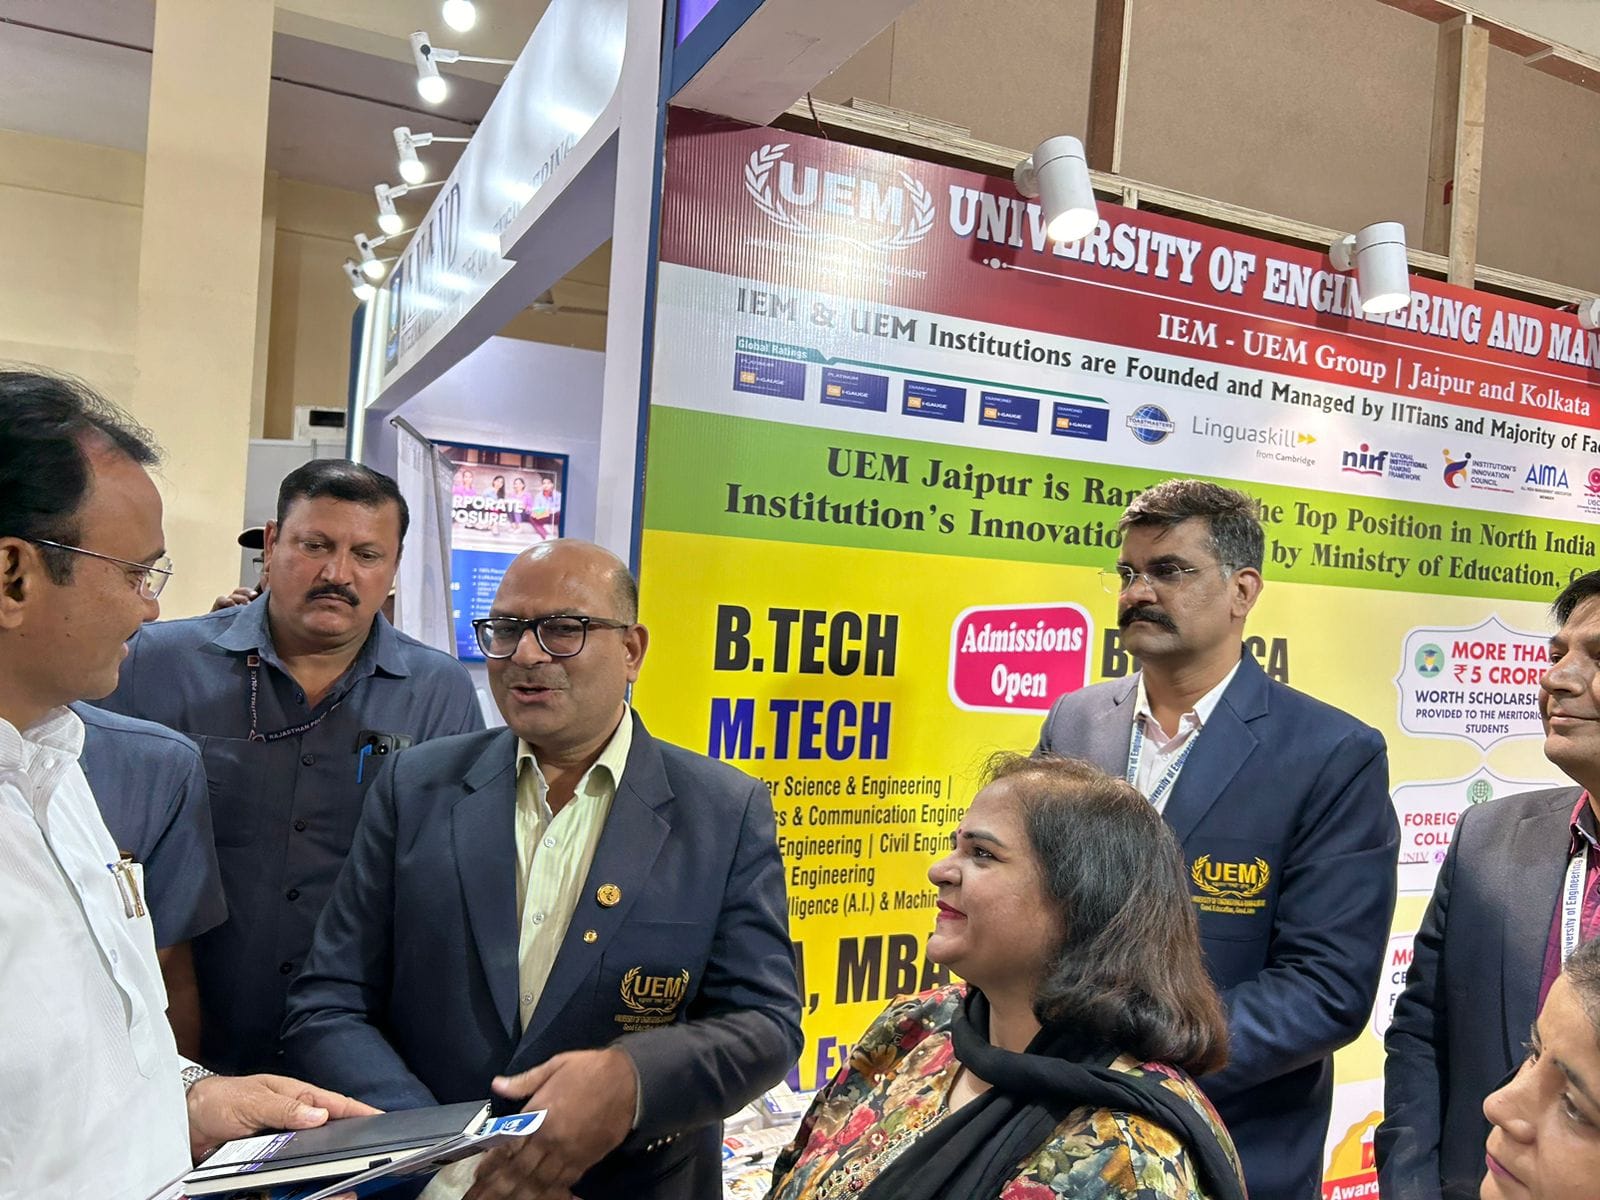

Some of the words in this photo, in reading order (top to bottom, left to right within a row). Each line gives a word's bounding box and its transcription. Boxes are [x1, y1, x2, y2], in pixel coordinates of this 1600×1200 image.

[778, 160, 904, 226] UEM
[1209, 246, 1256, 297] OF
[1487, 310, 1543, 358] AND
[738, 338, 769, 353] Global
[772, 344, 808, 360] Ratings
[736, 287, 798, 322] IEM
[809, 300, 835, 329] &
[849, 307, 918, 342] UEM
[928, 321, 1072, 368] Institutions
[1081, 351, 1117, 375] are
[1126, 357, 1219, 392] Founded
[1227, 376, 1264, 399] and
[1271, 381, 1354, 414] Managed
[1362, 395, 1384, 422] by
[1390, 401, 1449, 429] IITians
[1455, 412, 1484, 435] and
[1490, 420, 1556, 450] Majority
[1561, 433, 1578, 449] of
[1158, 314, 1218, 348] IEM
[1243, 328, 1308, 364] UEM
[1314, 345, 1387, 381] Group
[1408, 362, 1475, 395] Jaipur
[1479, 373, 1515, 402] and
[1520, 379, 1591, 417] Kolkata
[1192, 416, 1296, 448] Linguaskill
[1256, 450, 1274, 460] from
[1275, 453, 1316, 466] Cambridge
[1472, 460, 1517, 472] INSTITUTION'S
[1470, 477, 1498, 486] COUNCIL
[1471, 470, 1510, 480] INNOVATION
[1525, 464, 1569, 488] AIMA
[828, 447, 909, 484] UEM
[921, 459, 1033, 500] Jaipur
[1043, 473, 1069, 501] is
[1293, 501, 1338, 535] Top
[1347, 508, 1442, 540] Position
[1451, 521, 1472, 544] in
[1480, 524, 1537, 551] North
[1545, 531, 1596, 557] India
[724, 483, 955, 535] Institution's
[1271, 540, 1302, 568] by
[1310, 543, 1410, 578] Ministry
[1418, 555, 1443, 577] of
[714, 604, 899, 677] B.TECH
[960, 621, 1083, 653] Admissions
[1451, 641, 1507, 661] MORE
[991, 664, 1047, 703] Open
[1415, 690, 1465, 704] WORTH
[1416, 709, 1463, 720] PROVIDED
[1465, 710, 1477, 719] TO
[1480, 710, 1496, 719] THE
[269, 724, 310, 740] RAJASTHAN
[708, 698, 891, 761] M.TECH
[1465, 723, 1509, 734] STUDENTS
[784, 776, 841, 797] Science
[846, 776, 857, 794] &
[861, 775, 941, 799] Engineering
[793, 807, 803, 826] &
[809, 804, 916, 826] Communication
[778, 835, 862, 860] Engineering
[880, 832, 910, 853] Civil
[791, 864, 875, 889] Engineering
[1205, 862, 1257, 884] UEM
[843, 892, 875, 917] (A.I.)
[880, 891, 889, 911] &
[1567, 907, 1576, 916] of
[634, 975, 682, 998] UEM
